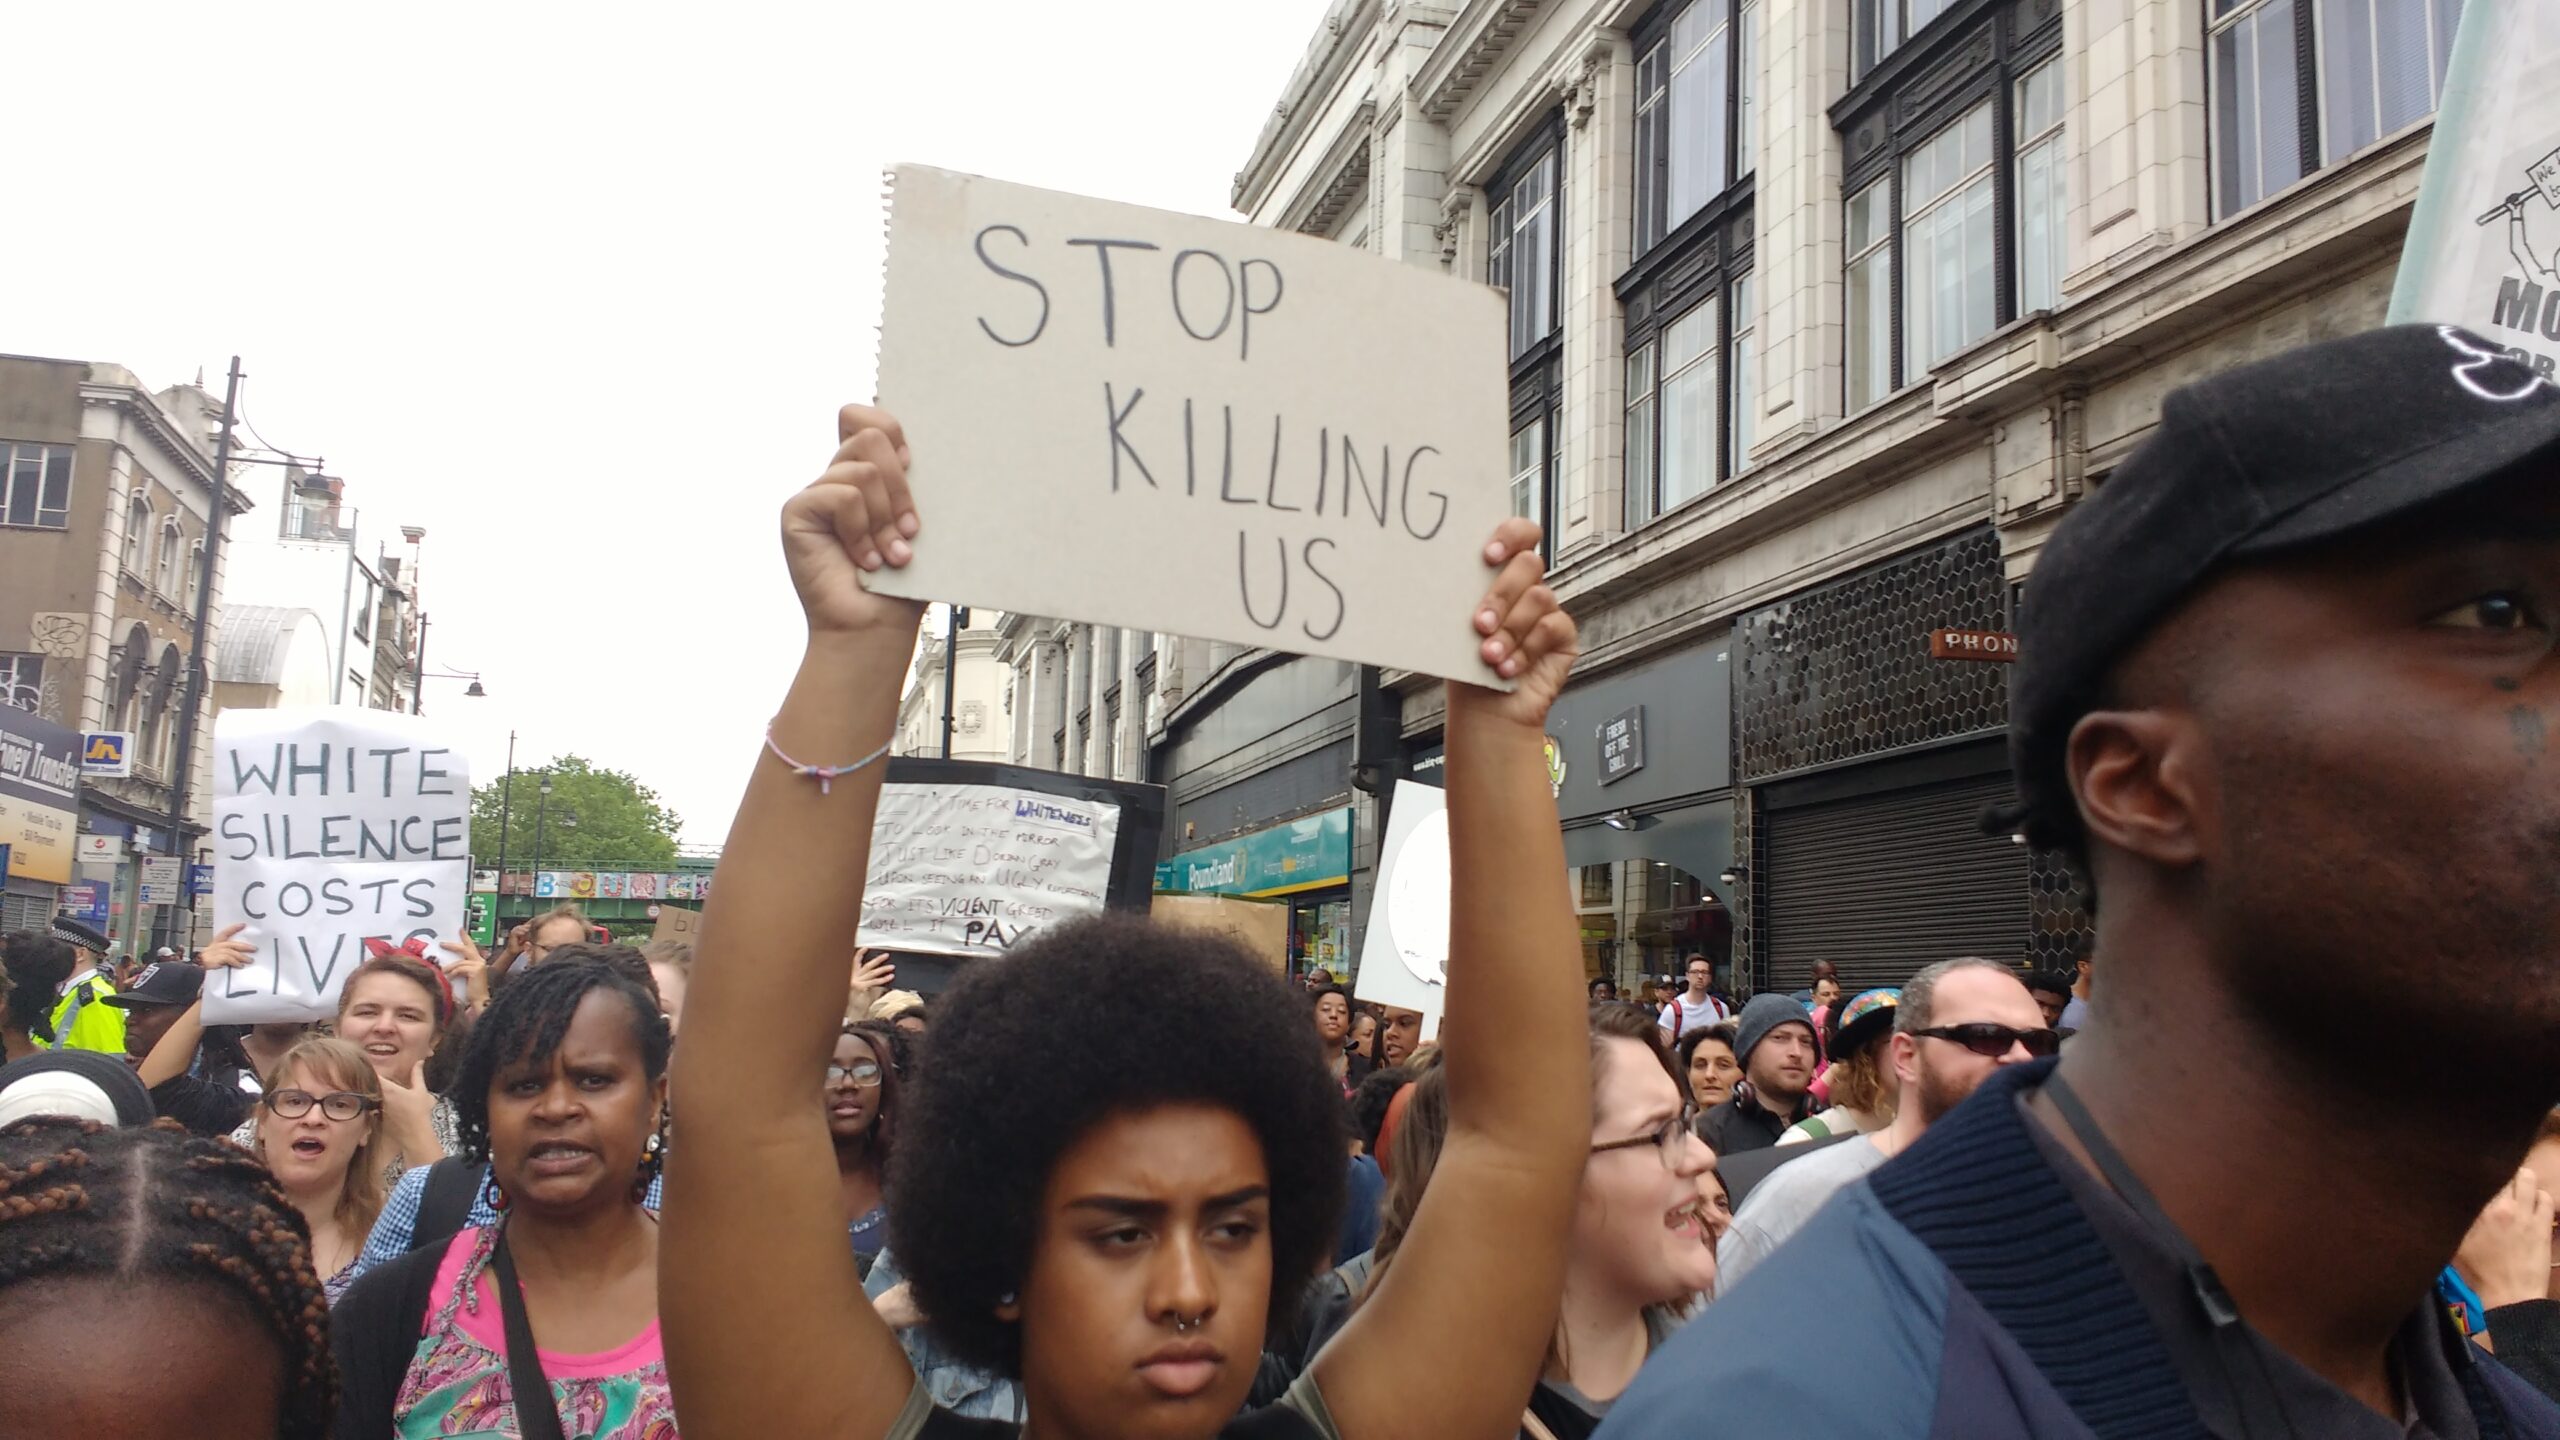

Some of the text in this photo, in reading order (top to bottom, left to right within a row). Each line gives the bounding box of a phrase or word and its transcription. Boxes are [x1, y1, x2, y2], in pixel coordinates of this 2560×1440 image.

[974, 224, 1284, 361] STOP
[1104, 381, 1448, 540] KILLING
[1239, 530, 1345, 640] US
[1945, 633, 2018, 653] PHON
[1606, 718, 1627, 741] FRESH
[0, 729, 80, 790] oney Transfer
[1605, 734, 1630, 758] OFF THE
[230, 743, 454, 798] WHITE
[986, 797, 1010, 811] FOR
[1015, 799, 1092, 827] WHITENESS
[221, 812, 465, 861] SILENCE
[1016, 832, 1060, 847] MIRROR
[194, 875, 214, 884] HA
[996, 867, 1044, 891] UGLY
[1188, 854, 1236, 891] Poundland
[242, 878, 436, 920] COSTS
[940, 896, 1005, 917] VIOLENT
[964, 917, 1037, 949] PAY
